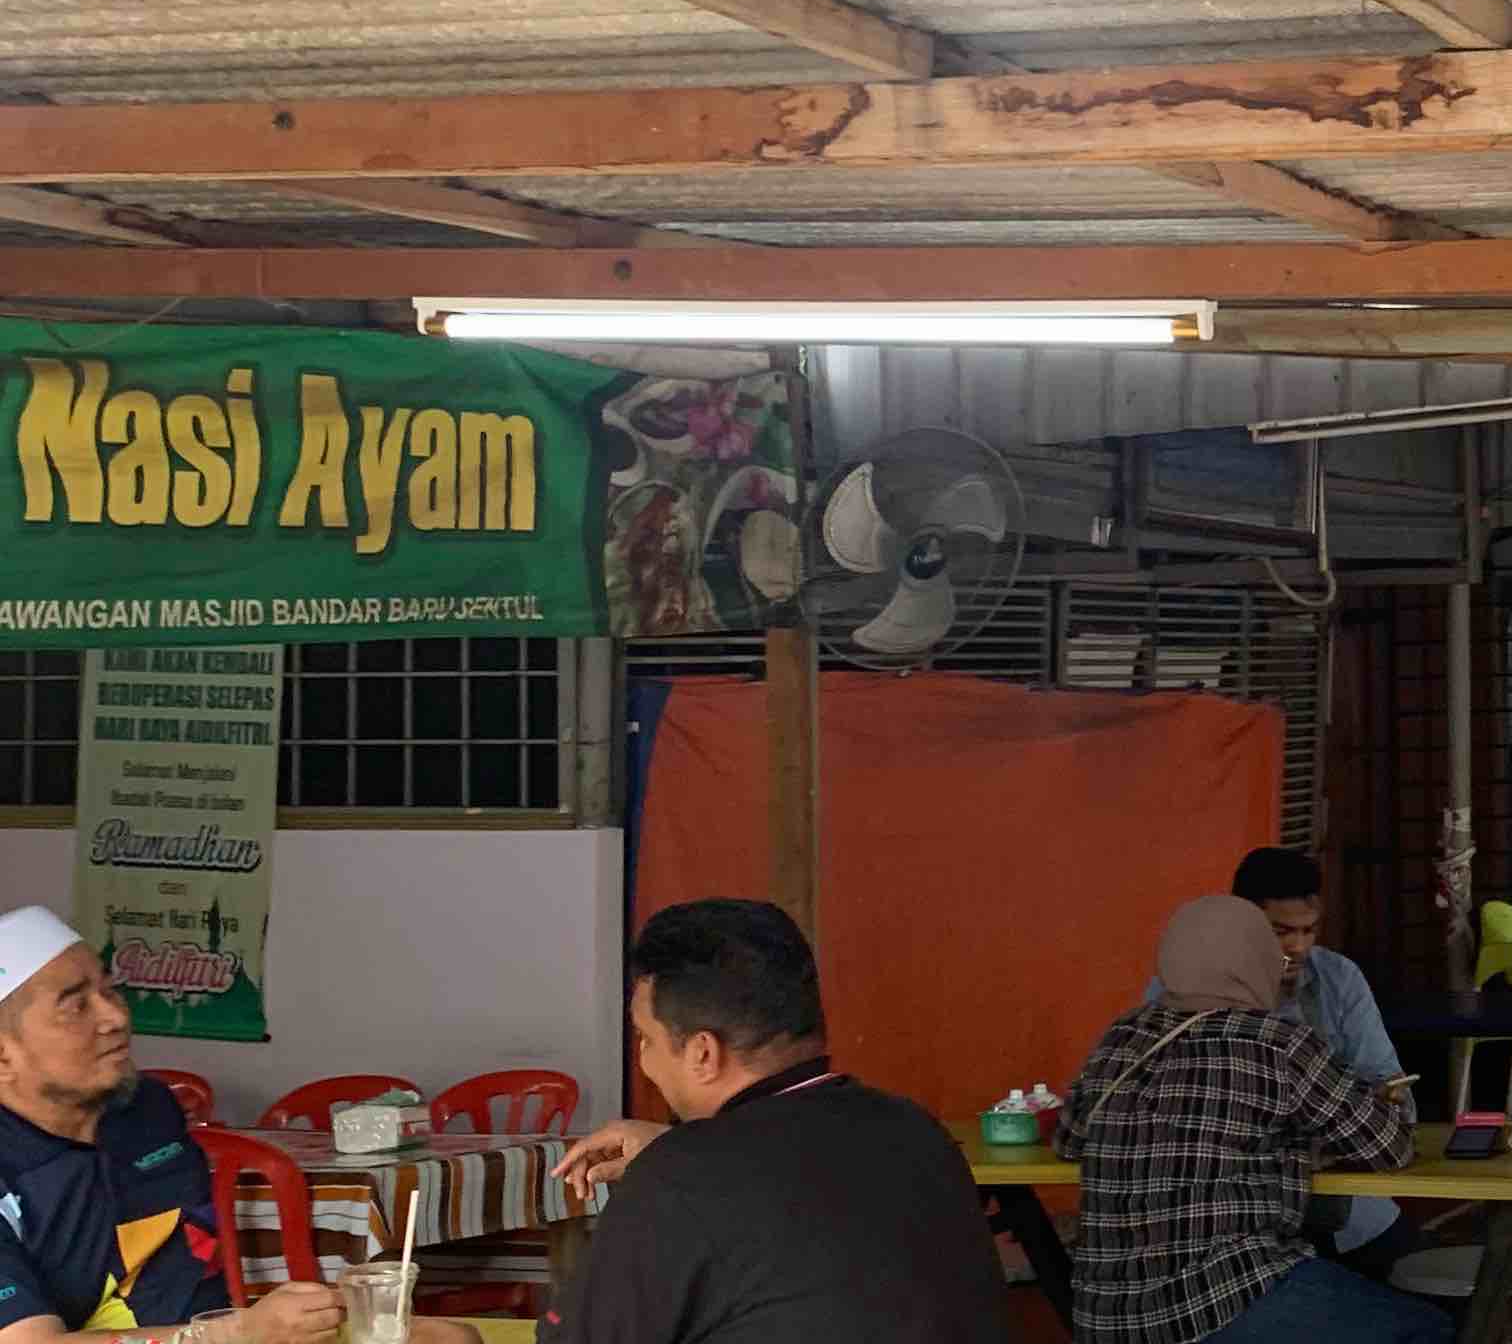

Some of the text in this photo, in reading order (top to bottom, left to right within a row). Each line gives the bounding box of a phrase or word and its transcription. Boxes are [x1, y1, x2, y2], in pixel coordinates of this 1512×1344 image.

[18, 357, 536, 554] Nasi Ayam
[160, 599, 265, 628] MASJID
[272, 598, 381, 626] BANDAR
[388, 597, 455, 622] BARU
[454, 595, 545, 621] SENTUL
[91, 817, 262, 872] Ramadhan
[201, 911, 239, 937] Rya
